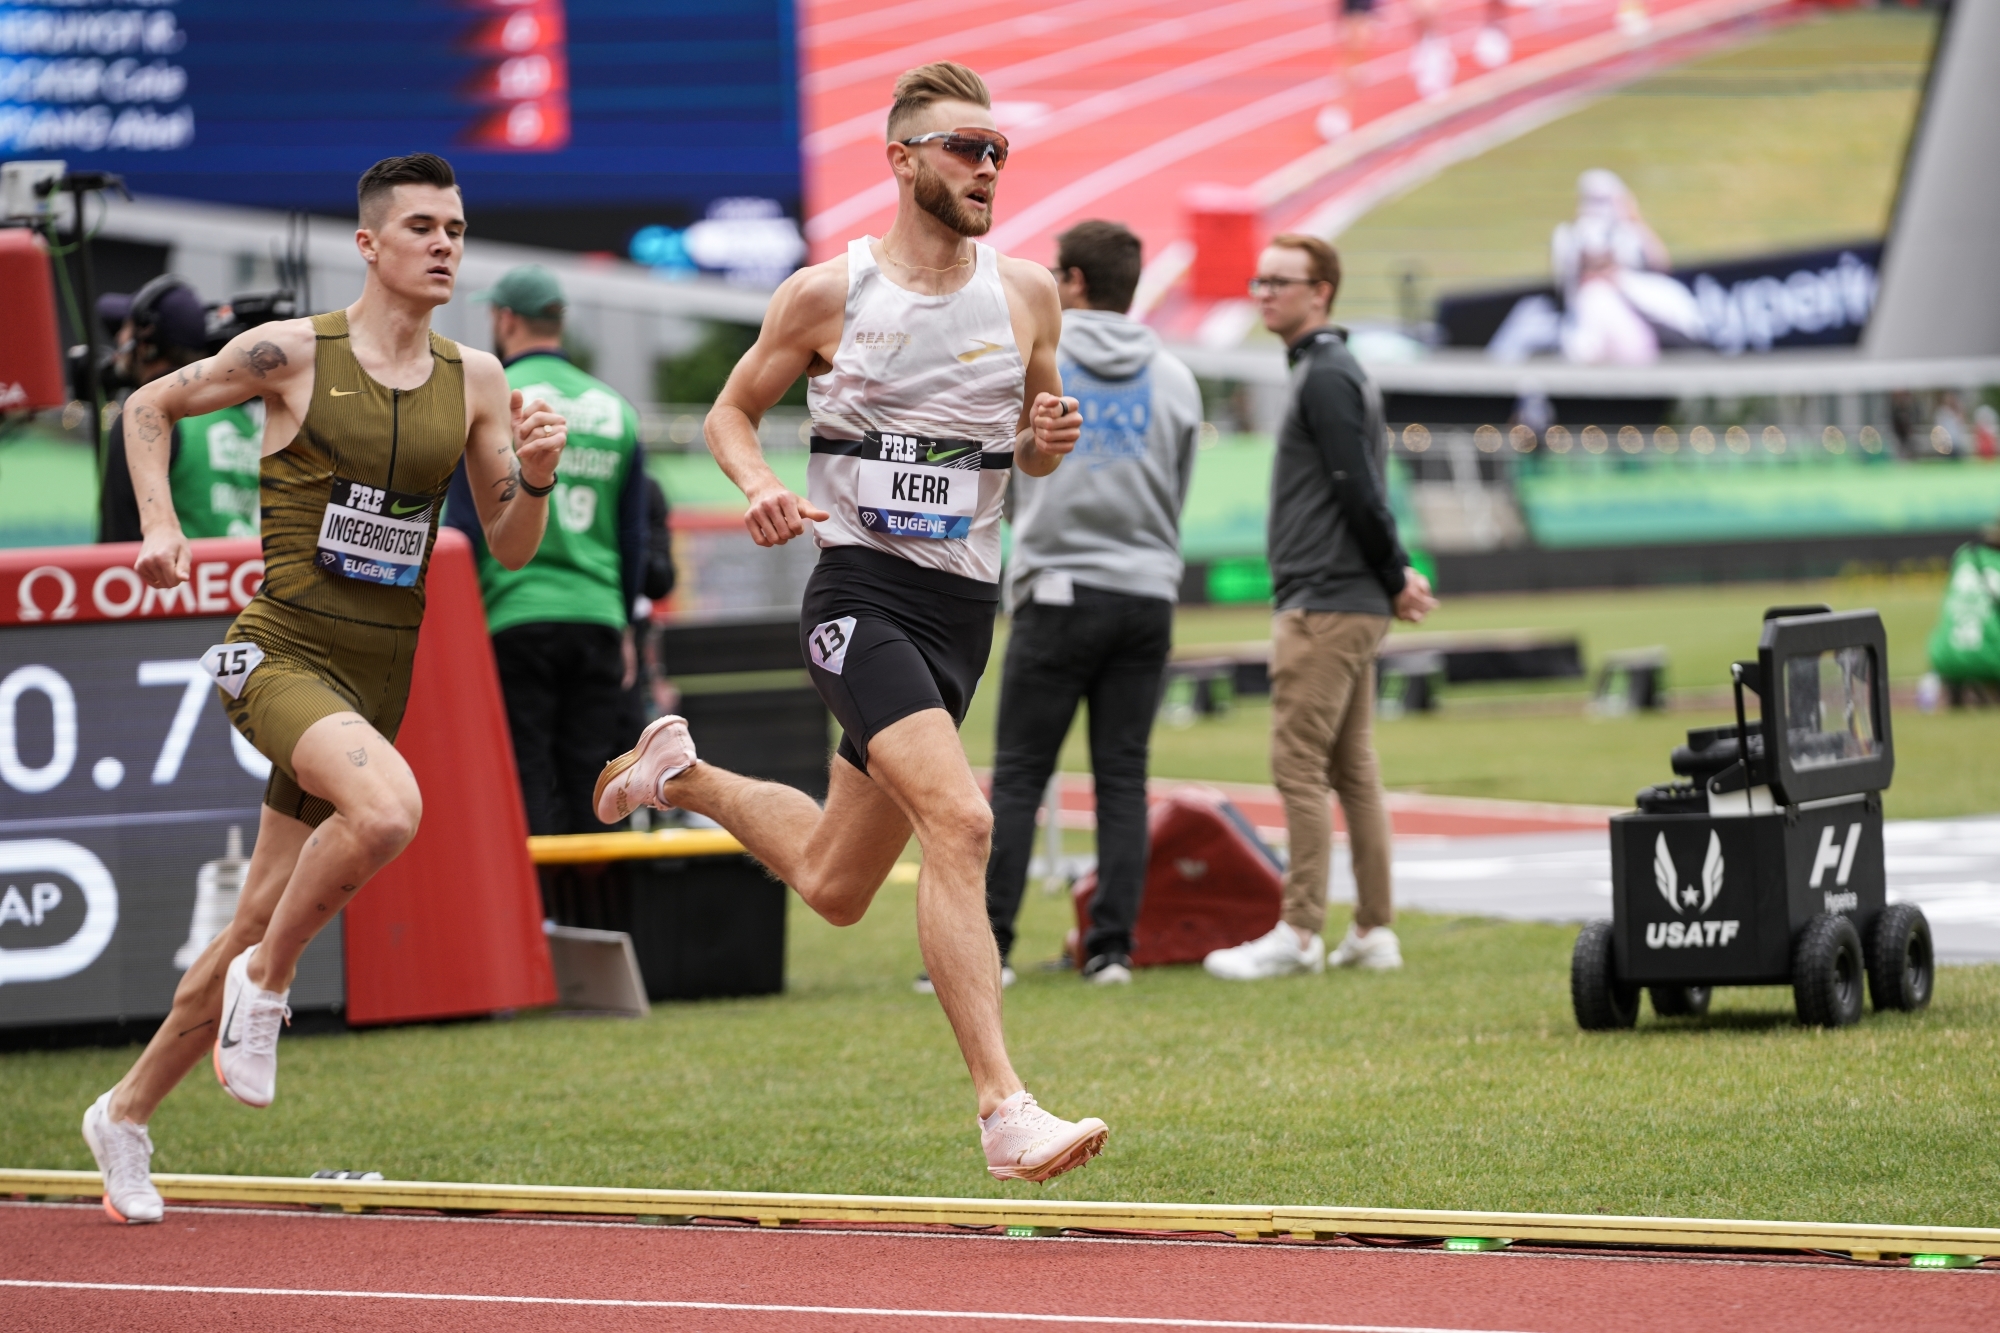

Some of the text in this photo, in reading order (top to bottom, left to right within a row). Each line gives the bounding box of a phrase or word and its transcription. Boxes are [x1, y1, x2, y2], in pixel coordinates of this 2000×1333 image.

[855, 332, 912, 344] BEASTS
[880, 434, 917, 462] PRE
[346, 483, 386, 514] PRE
[892, 471, 950, 505] KERR
[326, 513, 426, 556] INGEBRIGTSEN
[887, 515, 946, 533] EUGENE
[343, 559, 397, 580] EUGENE
[815, 623, 846, 663] 13
[216, 649, 248, 677] 15
[0, 658, 273, 793] 0.7
[0, 883, 63, 927] AP
[1646, 919, 1740, 949] USATF
